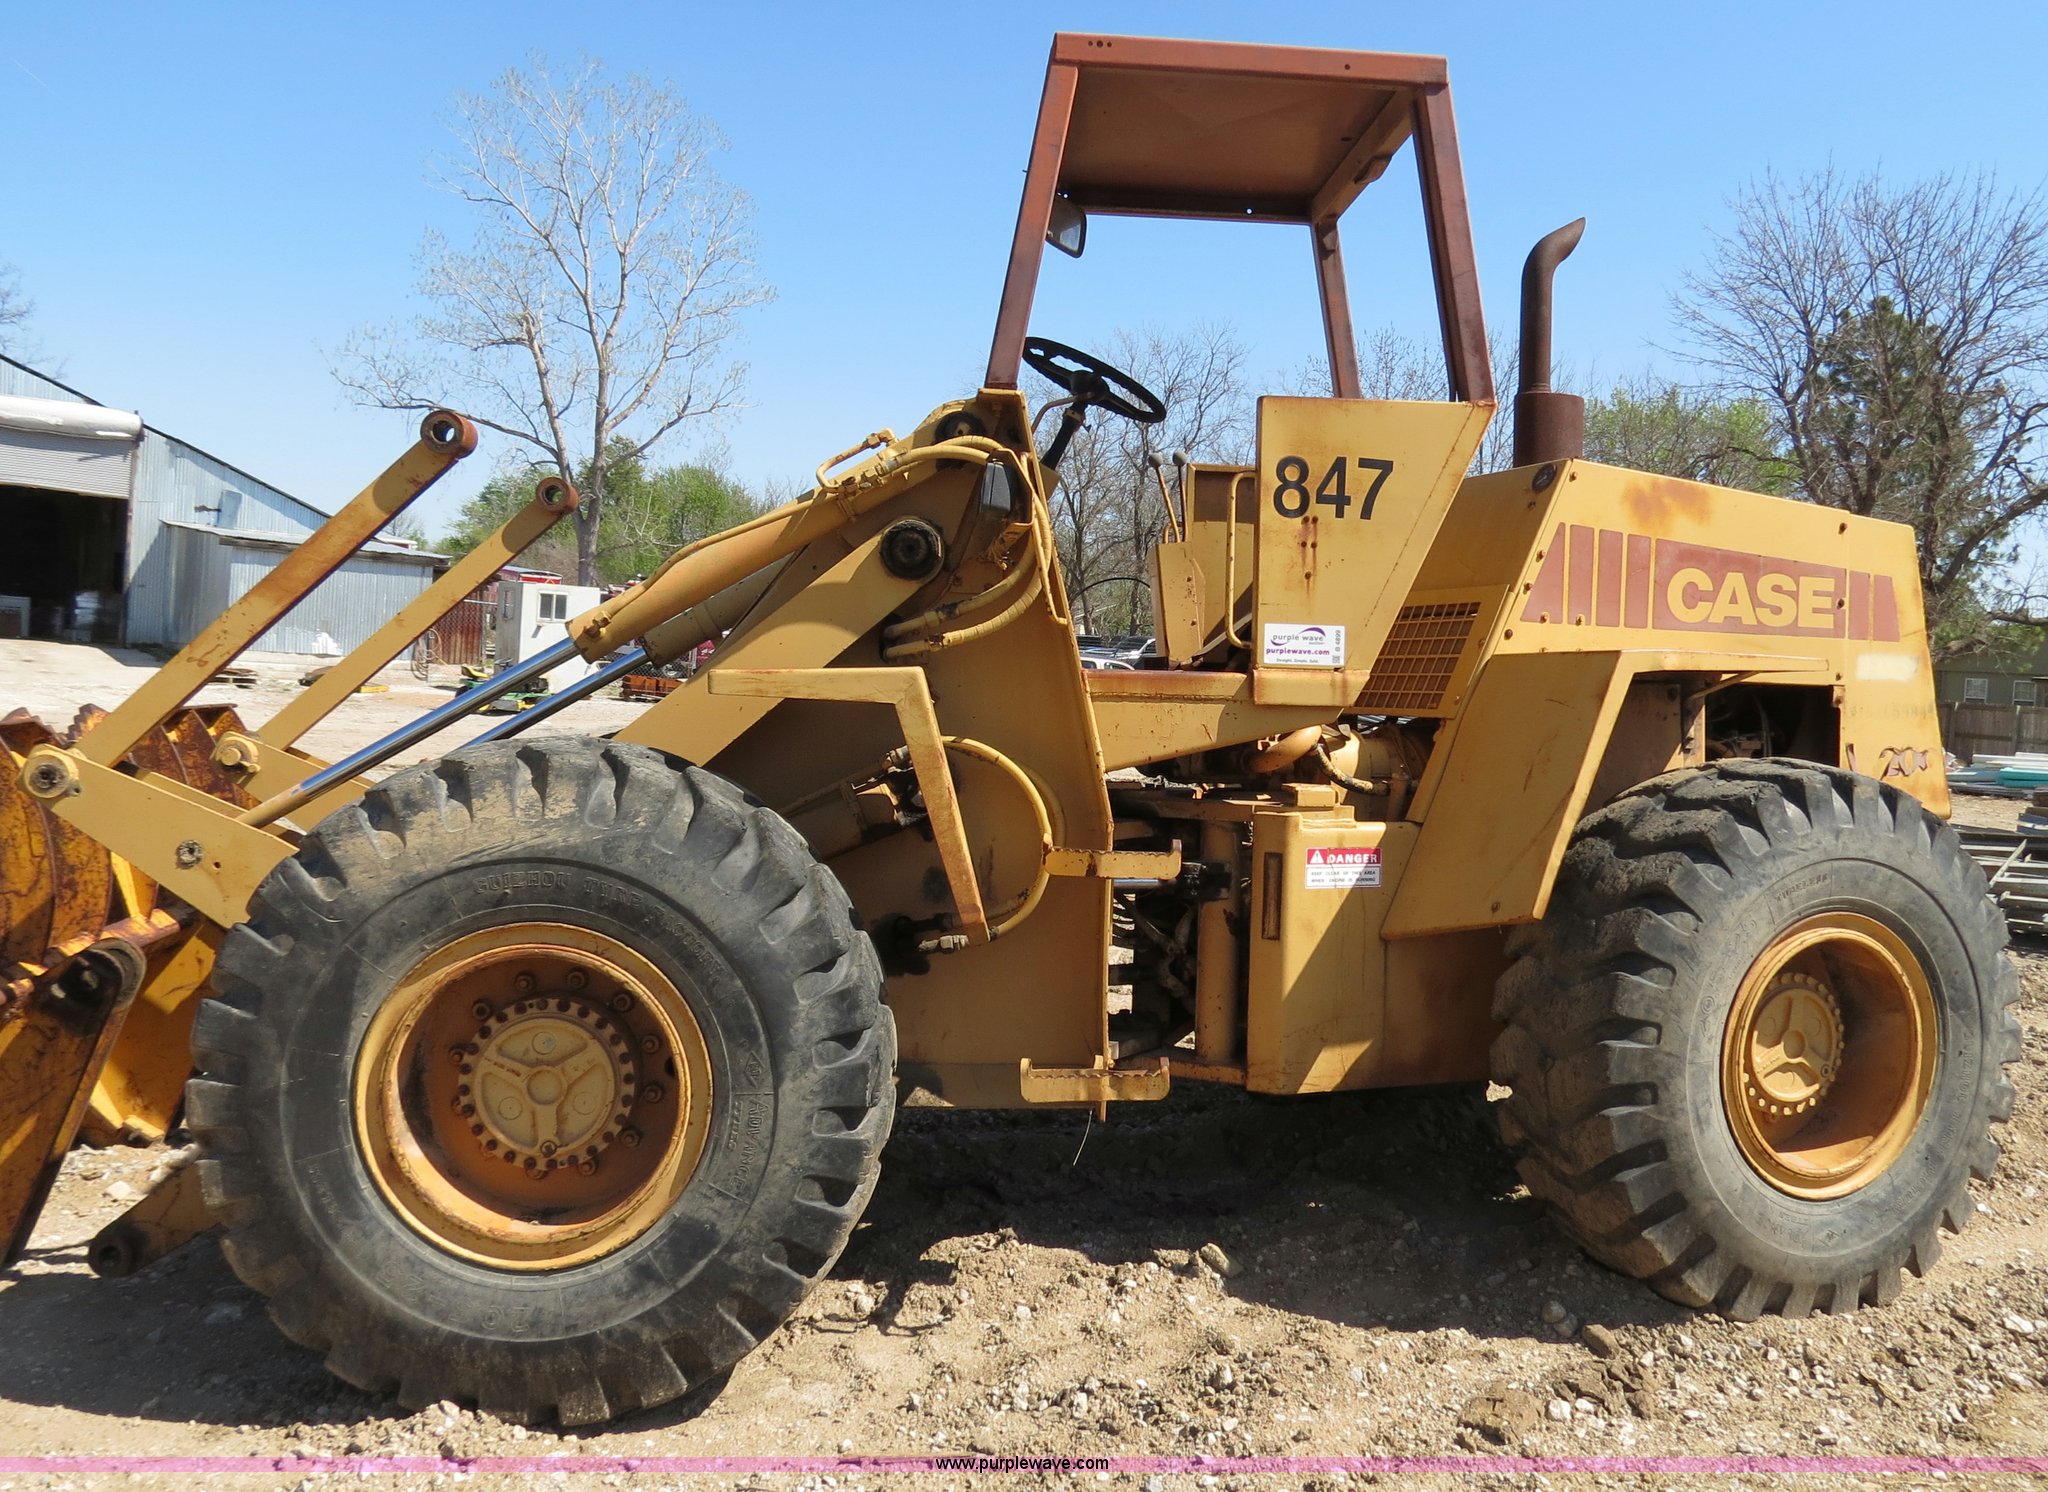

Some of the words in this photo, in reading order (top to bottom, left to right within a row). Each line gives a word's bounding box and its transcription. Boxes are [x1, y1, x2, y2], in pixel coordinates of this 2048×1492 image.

[1273, 455, 1394, 520] 847
[1667, 568, 1834, 629] CASE
[1272, 633, 1299, 642] purple
[1266, 647, 1330, 656] purplewave.com
[1326, 853, 1377, 863] DANGER
